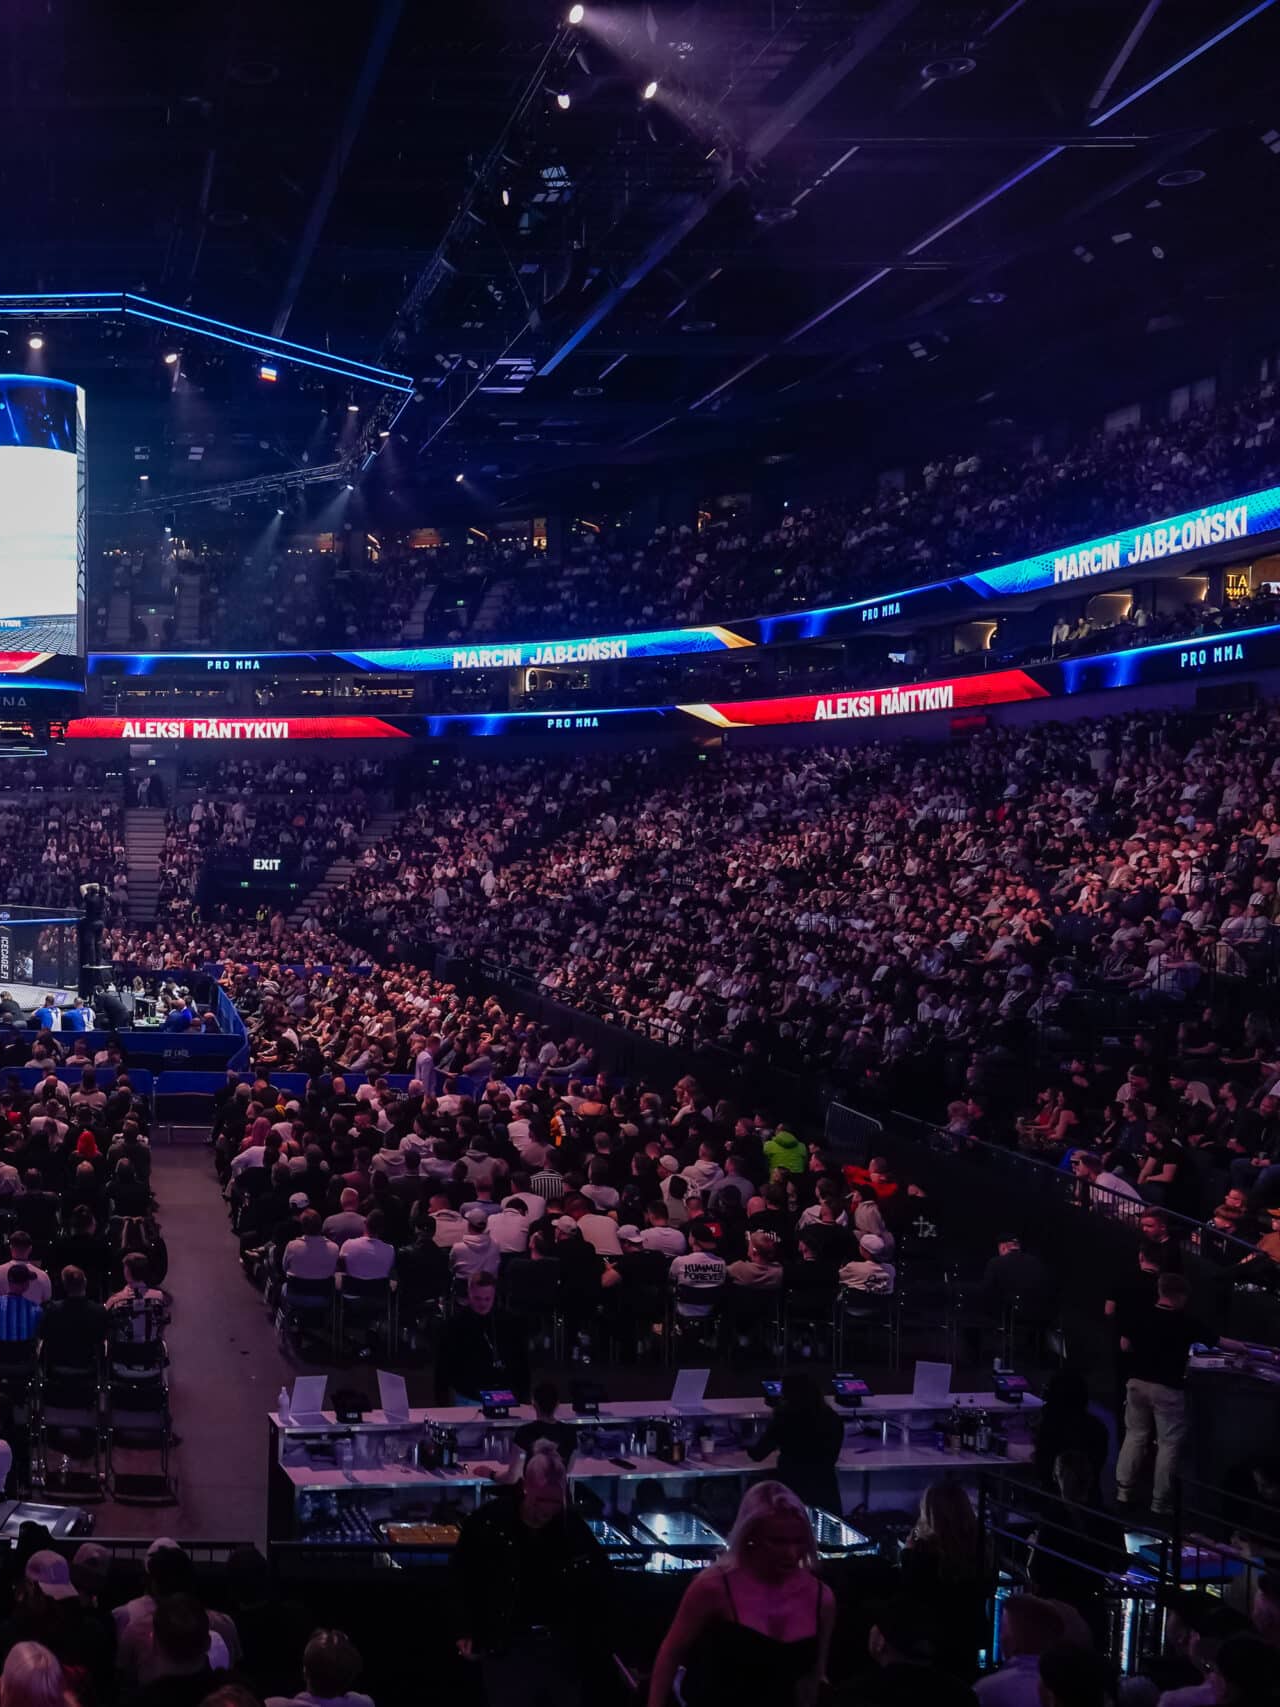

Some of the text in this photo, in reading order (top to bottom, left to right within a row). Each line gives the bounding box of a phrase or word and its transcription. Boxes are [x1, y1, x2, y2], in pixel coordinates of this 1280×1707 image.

[1054, 507, 1248, 584] MARCIN JABŁOŃSKI
[862, 602, 901, 622] PRO MMA
[452, 638, 628, 669] MARCIN JABŁOŃSKI
[1180, 643, 1244, 669] PRO MMA
[207, 661, 260, 670] PRO MMA
[814, 685, 954, 721] ALEKSI MÄNTYKIVI
[122, 719, 289, 739] ALEKSI MÄNTYKIVI
[547, 717, 599, 729] PRO MMA
[252, 858, 281, 871] EXIT
